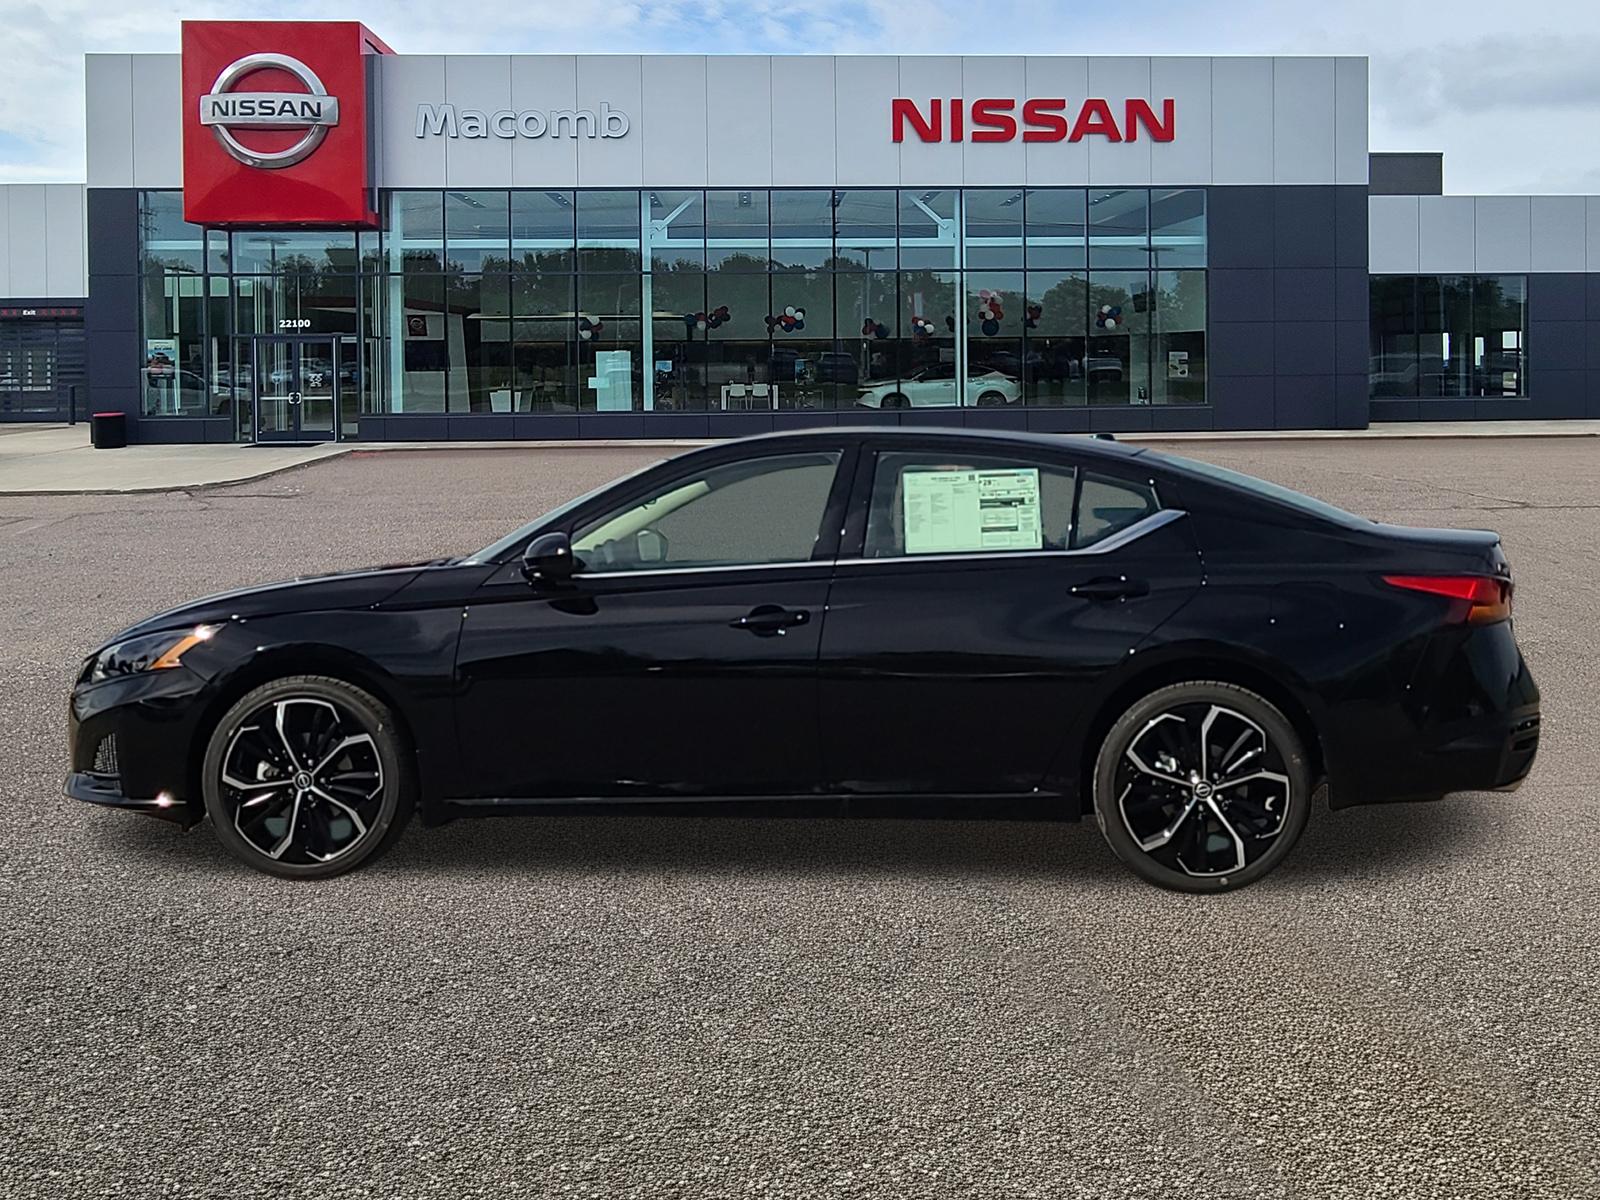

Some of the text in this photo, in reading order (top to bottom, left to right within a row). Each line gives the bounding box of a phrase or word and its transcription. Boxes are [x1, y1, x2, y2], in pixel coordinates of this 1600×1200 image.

[212, 100, 321, 117] NISSAN
[415, 102, 630, 139] Macomb
[892, 98, 1175, 143] NISSAN
[279, 319, 311, 328] 22100
